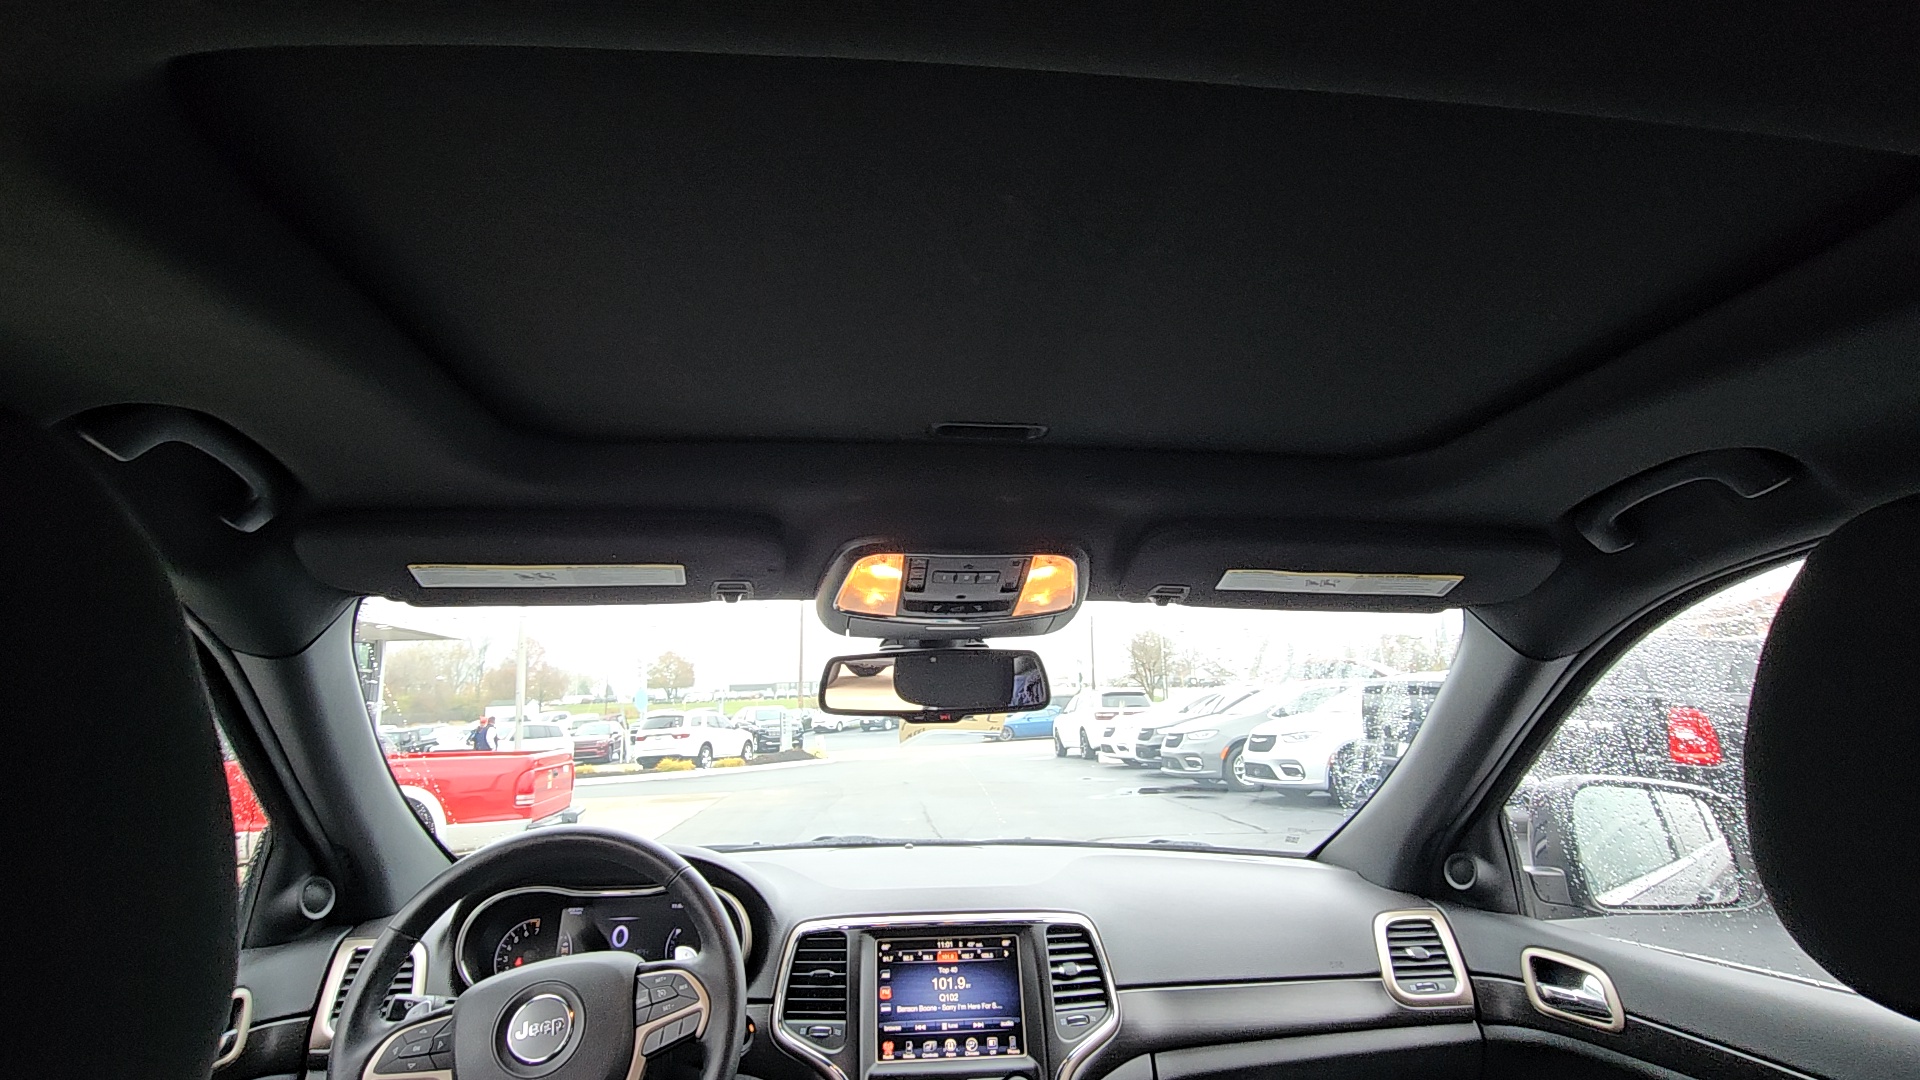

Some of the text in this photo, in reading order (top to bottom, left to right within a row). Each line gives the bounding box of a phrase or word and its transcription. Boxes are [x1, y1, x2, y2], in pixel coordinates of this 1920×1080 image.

[611, 925, 629, 948] 0
[931, 976, 966, 990] 101.9
[939, 993, 959, 1002] Q102
[919, 1004, 937, 1012] Boone
[942, 1003, 957, 1011] Sorry
[514, 1017, 565, 1040] Jeep
